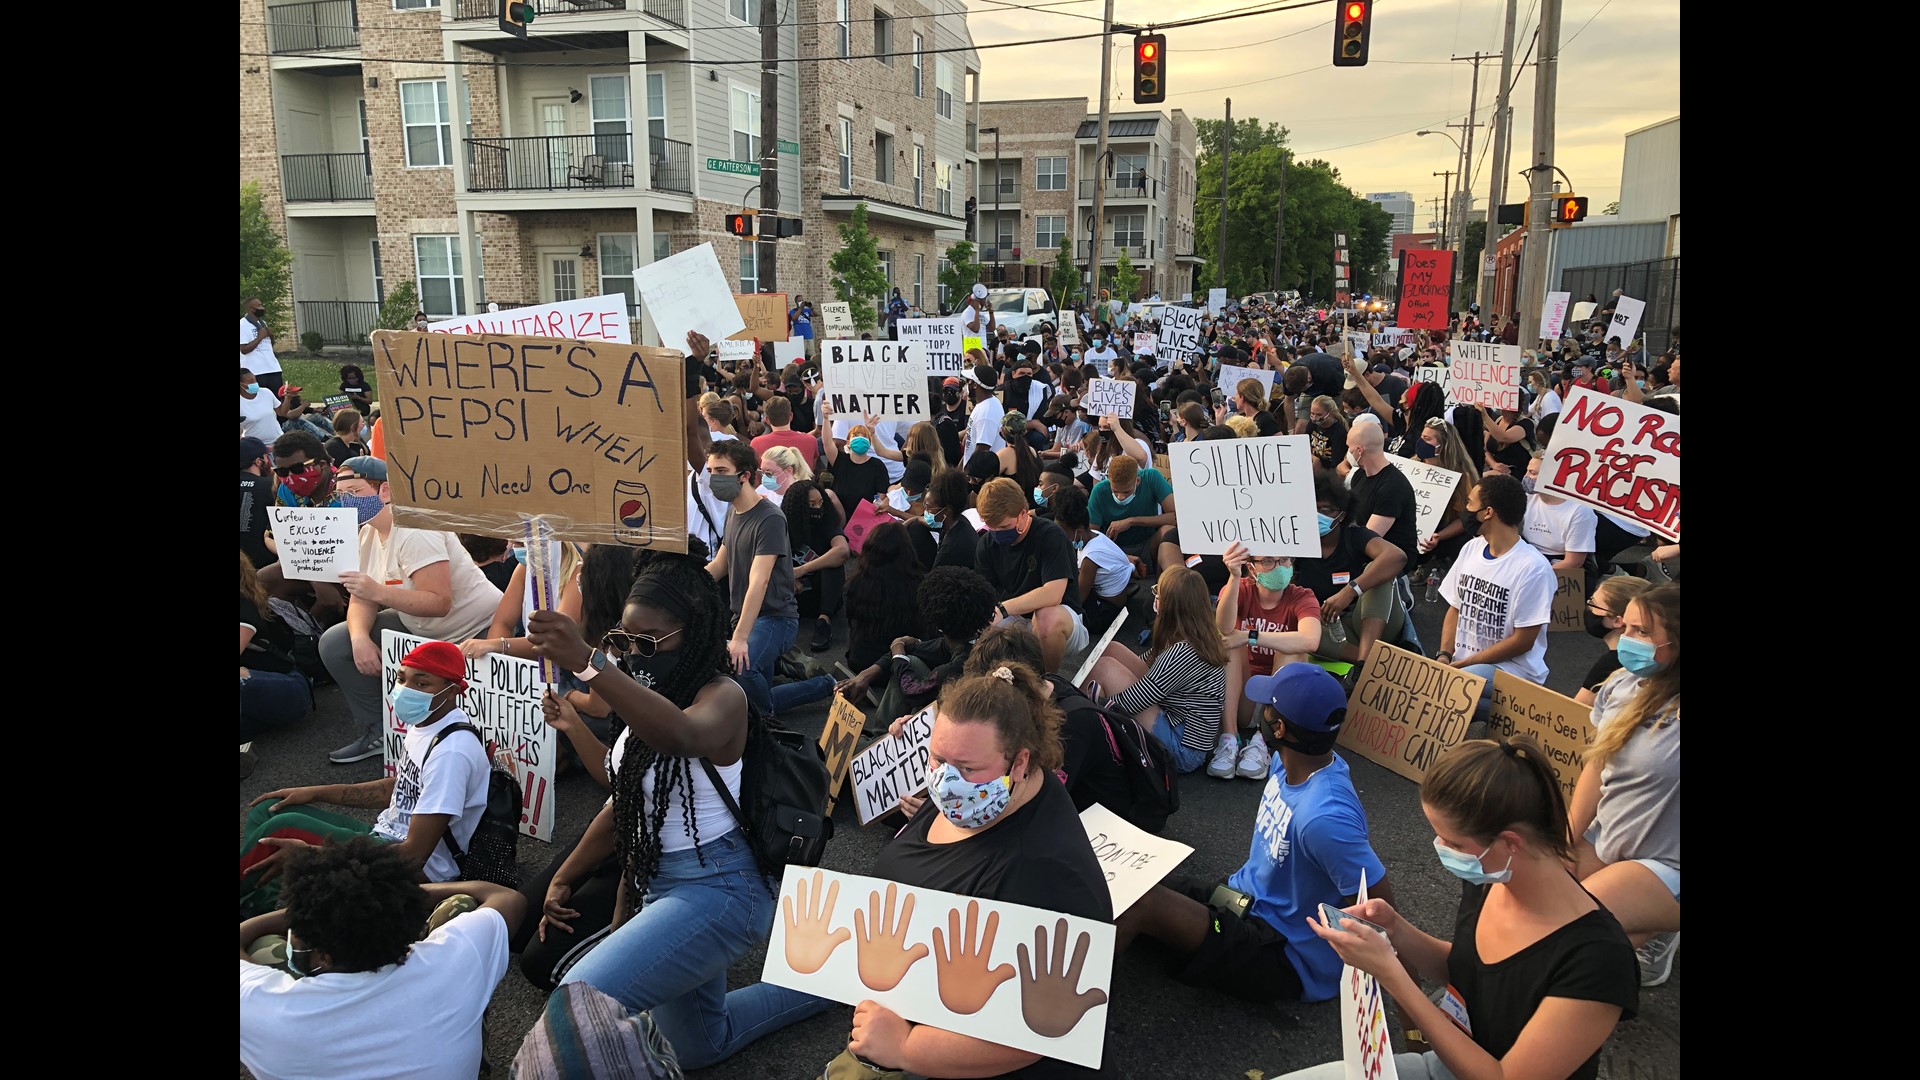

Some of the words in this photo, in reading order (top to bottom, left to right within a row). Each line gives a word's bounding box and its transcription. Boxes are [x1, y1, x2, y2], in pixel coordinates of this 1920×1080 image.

[718, 161, 752, 173] PATTERSON
[1407, 253, 1437, 269] Does
[823, 305, 847, 314] SILENCE
[1614, 313, 1629, 323] NOT
[432, 310, 619, 339] MILITARIZE
[902, 324, 922, 335] WANT
[928, 324, 955, 335] THESE
[1159, 330, 1198, 351] LIVES
[831, 345, 910, 364] BLACK
[1157, 345, 1193, 363] MATTER
[1457, 345, 1501, 362] WHITE
[381, 337, 603, 398] WHERE'S
[617, 351, 664, 413] A
[830, 363, 920, 391] LIVES
[1453, 360, 1519, 388] SILENCE
[1474, 381, 1483, 391] IS
[1092, 392, 1129, 405] LIVES
[1094, 381, 1133, 396] BLACK
[1452, 386, 1519, 411] VIOLENCE
[831, 393, 921, 415] MATTER
[1089, 403, 1132, 418] MATTER
[1562, 395, 1625, 437] NO
[395, 395, 529, 442] PEPSI
[556, 406, 658, 474] WHEN
[1189, 443, 1292, 488] SILENCE
[1595, 437, 1657, 473] for
[389, 451, 463, 503] You
[481, 463, 532, 498] Need
[549, 468, 591, 496] One
[1410, 466, 1421, 475] IS
[1425, 467, 1453, 485] FREE
[1232, 487, 1253, 511] IS
[274, 508, 304, 523] Curfew
[309, 513, 316, 521] is
[289, 525, 327, 536] EXCUSE
[1202, 515, 1300, 545] VIOLENCE
[302, 545, 336, 556] VIOLENCE
[1474, 577, 1510, 602] BREATHE
[1470, 605, 1506, 627] BEATHE
[490, 656, 541, 701] POLICE
[1371, 645, 1477, 715] BUILDINGS
[835, 701, 862, 731] Matter
[1359, 680, 1394, 715] CAN
[1388, 690, 1419, 725] BE
[1415, 701, 1466, 748] FIXED
[1509, 694, 1525, 717] You
[1528, 703, 1553, 728] Can't
[1554, 715, 1578, 740] See
[1343, 709, 1406, 760] MURDER
[852, 739, 895, 786] BLACK
[892, 710, 931, 759] LIVES
[865, 745, 929, 817] MATTER
